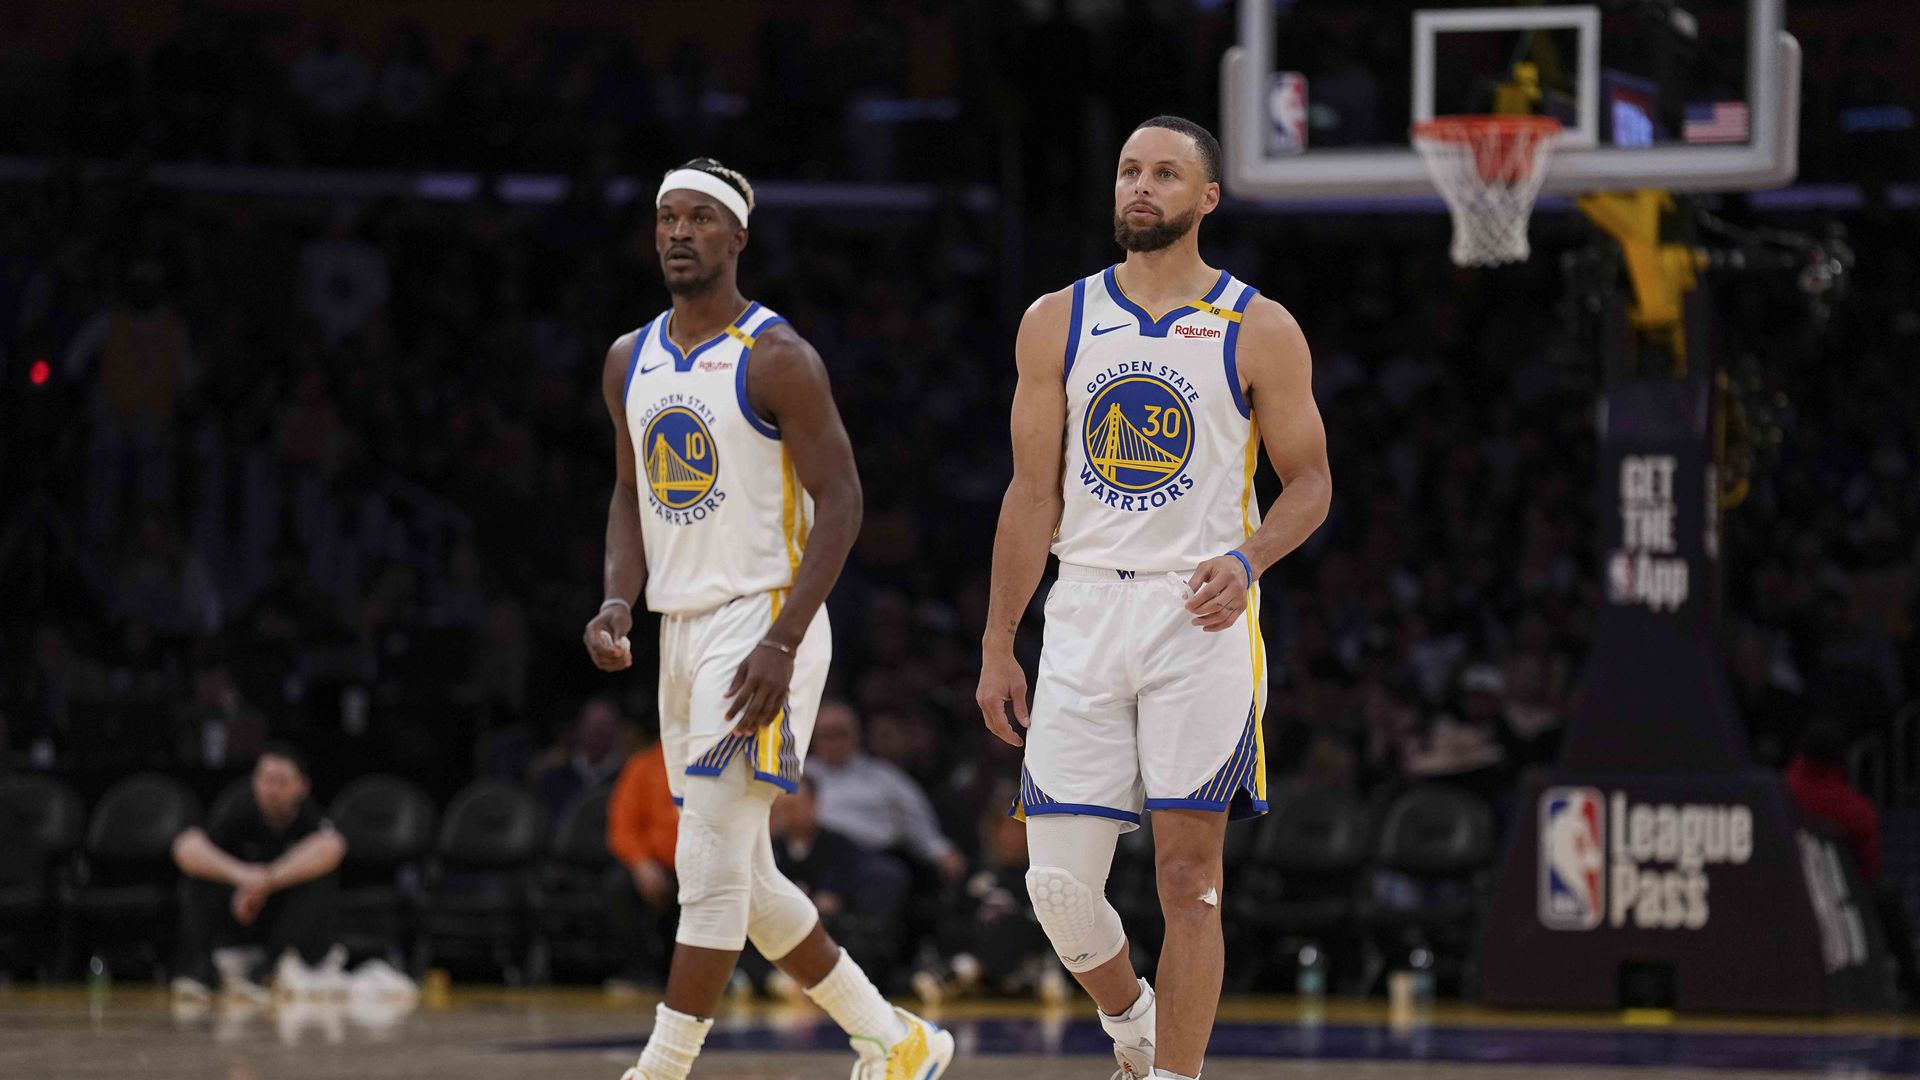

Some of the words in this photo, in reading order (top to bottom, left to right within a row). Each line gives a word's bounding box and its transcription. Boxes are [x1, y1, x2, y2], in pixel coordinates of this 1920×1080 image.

[1174, 325, 1221, 339] Rakuten
[1209, 306, 1221, 316] 16
[1086, 360, 1152, 394] GOLDEN
[1158, 365, 1200, 404] STATE
[640, 393, 684, 427] GOLDEN
[688, 395, 716, 426] STATE
[1141, 404, 1181, 438] 30
[685, 432, 706, 461] 10
[1079, 462, 1194, 512] WARRIORS
[1621, 455, 1677, 500] GET
[1621, 502, 1677, 553] THE
[1609, 790, 1754, 868] League
[1609, 859, 1709, 929] Pass
